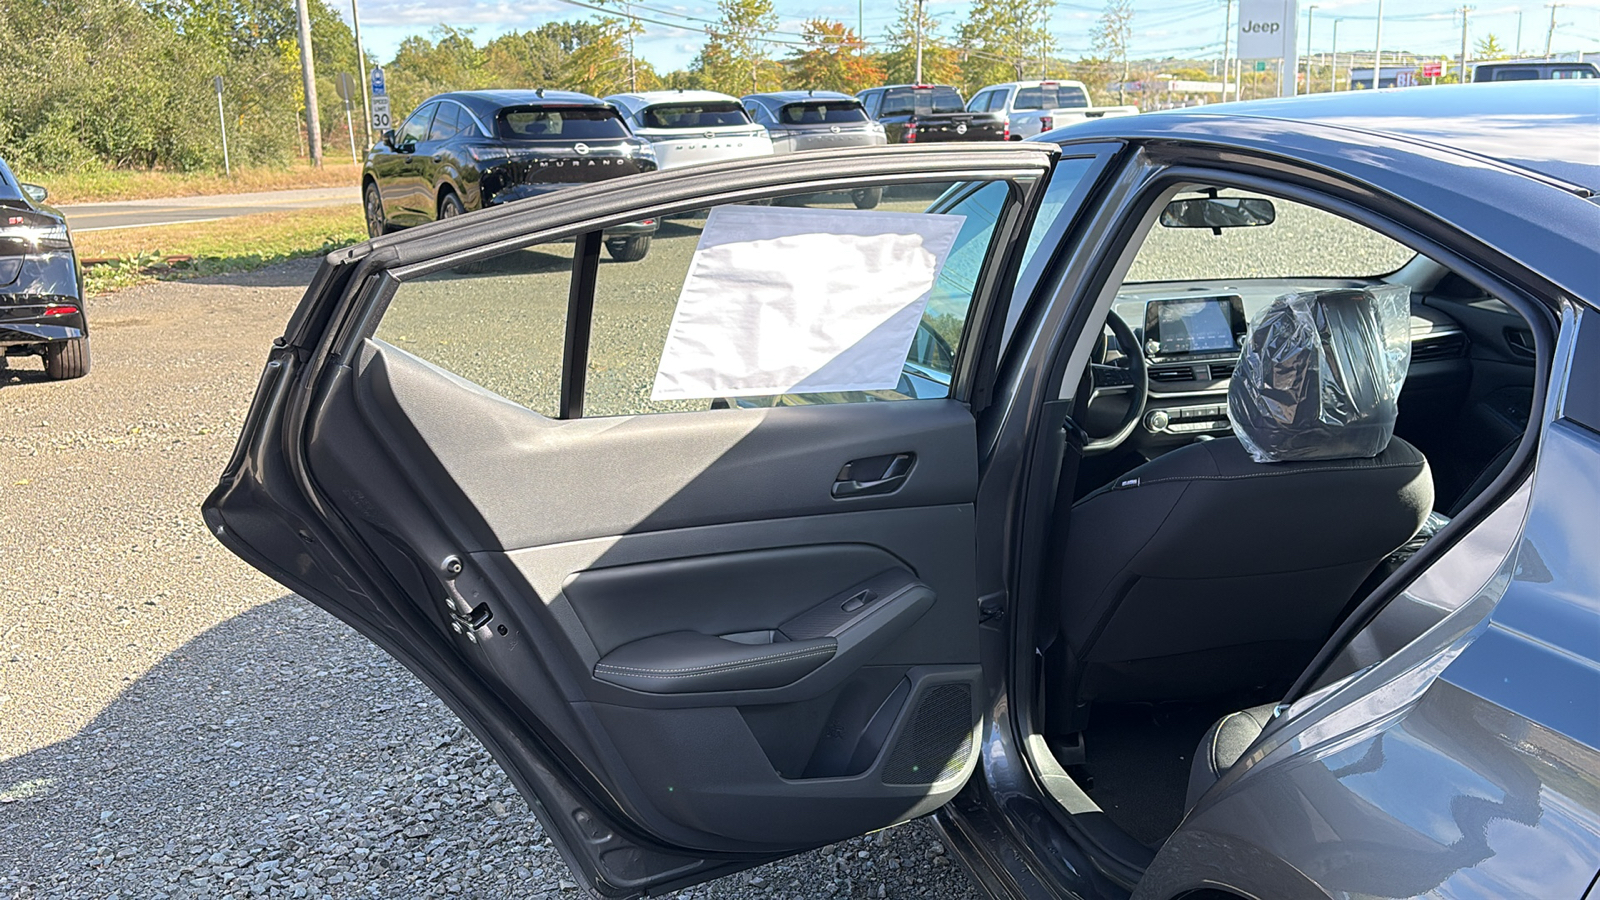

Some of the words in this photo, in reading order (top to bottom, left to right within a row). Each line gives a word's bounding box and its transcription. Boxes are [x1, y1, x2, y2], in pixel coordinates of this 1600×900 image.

[1242, 20, 1280, 35] Jeep
[374, 114, 389, 127] 30
[540, 159, 624, 167] MURANO
